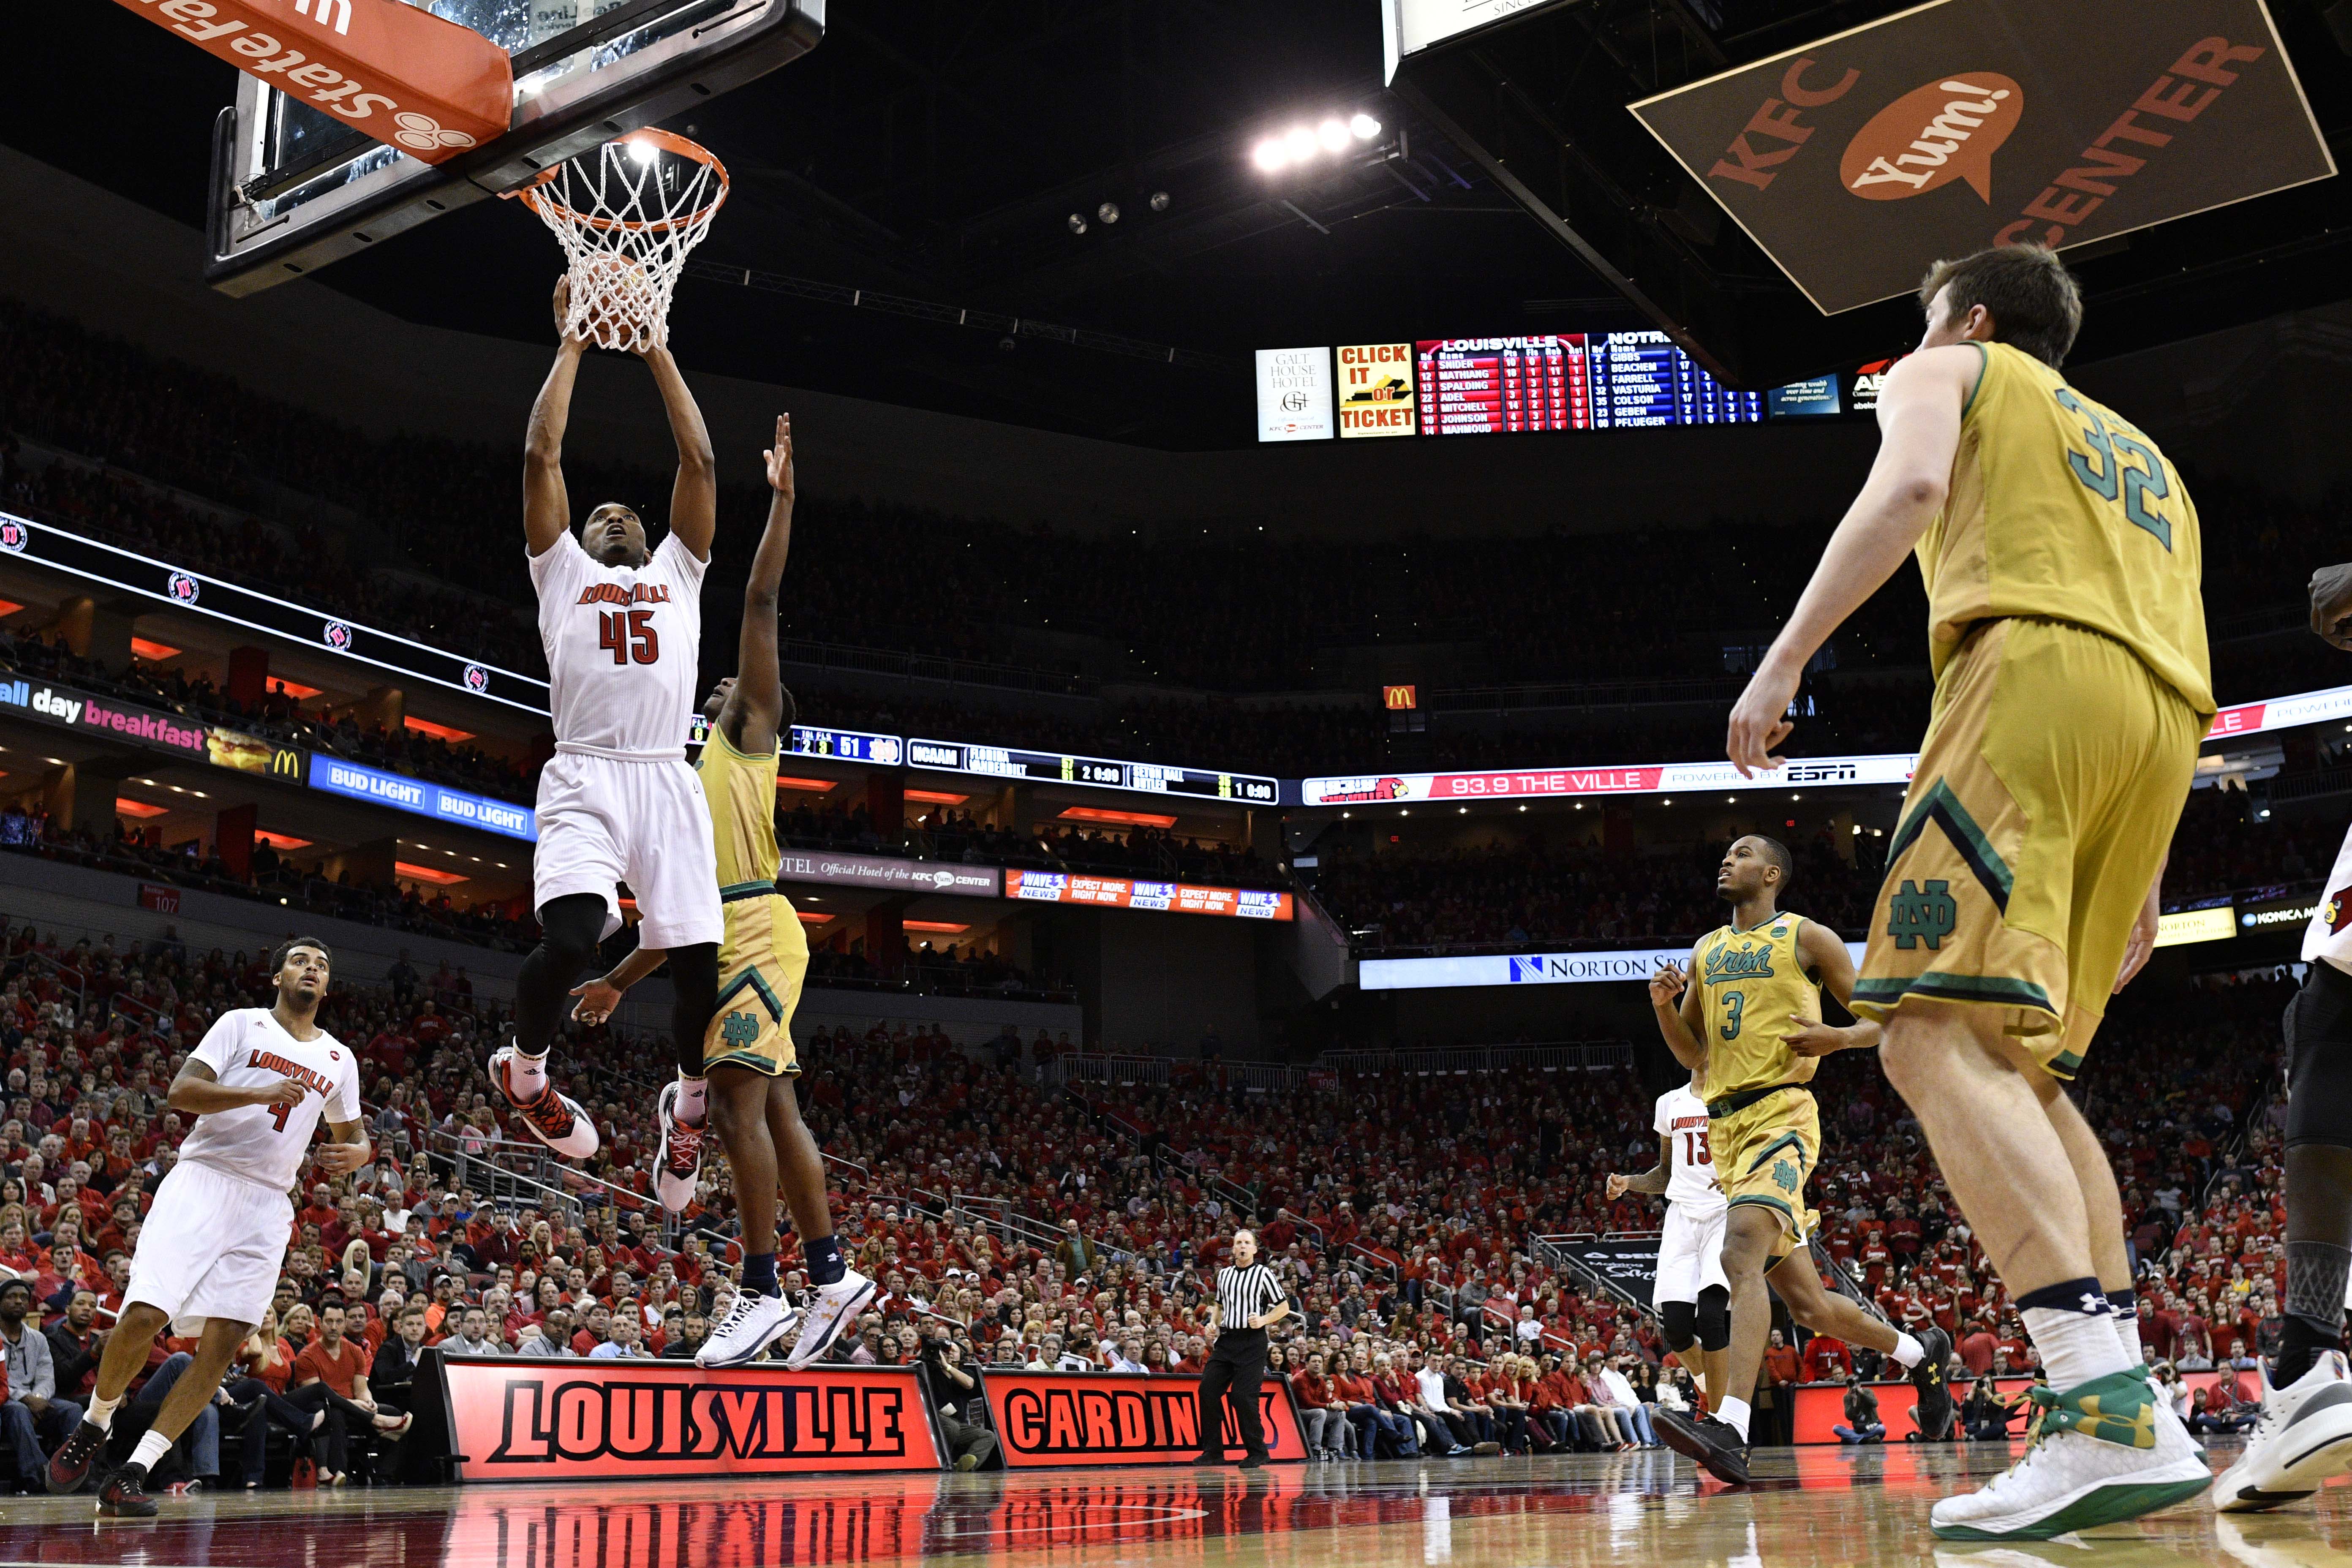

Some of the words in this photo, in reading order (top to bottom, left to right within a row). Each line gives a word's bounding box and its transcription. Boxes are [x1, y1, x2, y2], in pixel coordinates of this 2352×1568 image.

[1707, 58, 1860, 191] KFC
[1850, 81, 2010, 189] Yum!
[1992, 35, 2265, 250] CENTER
[1443, 335, 1558, 352] LOUISVILLE
[1608, 331, 1671, 344] NOTR
[1276, 353, 1309, 365] GALT
[1342, 346, 1407, 364] CLICK
[1595, 354, 1601, 362] 2
[1611, 353, 1640, 362] GIBBS
[1681, 351, 1686, 359] 2
[1271, 365, 1317, 376] HOUSE
[1439, 360, 1474, 369] SNIDER
[1505, 358, 1516, 366] 10
[1596, 365, 1602, 373] 3
[1611, 363, 1657, 372] BEACHEM
[1680, 361, 1689, 370] 17
[1272, 377, 1317, 388] HOTEL
[1350, 368, 1369, 384] IT
[1421, 373, 1431, 381] 12
[1439, 370, 1489, 380] MATHIANG
[1597, 376, 1603, 384] 5
[1612, 374, 1655, 384] FARRELL
[1682, 372, 1688, 381] 9
[1422, 384, 1432, 392] 13
[1440, 381, 1488, 391] SPALDING
[1509, 380, 1514, 388] 2
[1596, 387, 1606, 395] 32
[1612, 384, 1661, 395] VASTURIA
[1683, 383, 1689, 392] 4
[1372, 387, 1395, 401] or
[1422, 394, 1433, 403] 22
[1440, 393, 1465, 401] ADEL
[1510, 390, 1515, 399] 3
[1596, 397, 1607, 406] 35
[1613, 395, 1654, 405] COLSON
[1682, 393, 1693, 402] 17
[1423, 405, 1433, 413] 45
[1441, 402, 1488, 412] MITCHELL
[1508, 401, 1519, 409] 14
[1597, 408, 1608, 417] 23
[1614, 407, 1647, 416] GEBEN
[1685, 405, 1690, 414] 2
[1341, 408, 1413, 427] TICKET
[1424, 416, 1434, 424] 10
[1442, 414, 1487, 423] JOHNSON
[1511, 412, 1516, 420] 4
[1598, 419, 1609, 427] 00
[1615, 417, 1666, 427] PFLUEGER
[1686, 416, 1691, 425] 0
[1424, 427, 1434, 435] 14
[1442, 424, 1491, 434] MAHMOUD
[1511, 423, 1517, 431] 2
[2055, 388, 2172, 554] 32
[599, 610, 659, 665] 45
[2278, 699, 2352, 716] POWER
[0, 681, 29, 707] all
[33, 688, 82, 724] day
[85, 699, 203, 751] breakfast
[692, 718, 708, 728] FLS
[816, 731, 832, 740] FLS
[803, 740, 811, 753] 2
[840, 737, 859, 756] 51
[1083, 766, 1090, 779] 2
[1761, 771, 1781, 779] BY
[1788, 765, 1855, 781] ESPN
[331, 767, 368, 791] BUD
[370, 778, 422, 804] LIGHT
[1236, 783, 1242, 796] 1
[1452, 777, 1509, 794] 93.9
[1517, 776, 1565, 791] THE
[1572, 772, 1641, 789] VILLE
[441, 796, 475, 817] BUD
[477, 805, 524, 830] LIGHT
[821, 863, 855, 876] Official
[858, 864, 882, 878] Hotel
[885, 868, 896, 880] of
[896, 867, 909, 879] the
[911, 872, 932, 882] KFC
[936, 875, 953, 883] Yum!
[956, 878, 990, 887] CENTER
[1024, 873, 1052, 887] WAVE
[1050, 874, 1064, 889] 3
[1071, 879, 1101, 890] EXPECT
[1102, 882, 1127, 893] MORE.
[1134, 883, 1162, 897] WAVE
[1160, 884, 1173, 898] 3
[1023, 889, 1056, 898] NEWS
[1071, 889, 1096, 899] RIGHT
[1098, 891, 1117, 901] NOW.
[1180, 889, 1208, 899] EXPECT
[1210, 891, 1233, 901] MORE.
[1241, 892, 1267, 906] WAVE
[1264, 893, 1277, 907] 3
[156, 896, 177, 913] 107
[1134, 899, 1165, 907] NEWS
[1180, 898, 1204, 908] RIGHT
[1205, 901, 1224, 910] NOW.
[1241, 907, 1270, 916] NEWS
[2257, 909, 2303, 924] KONICA
[1551, 959, 1646, 977] NORTON
[1704, 942, 1774, 985] Irish
[1720, 991, 1744, 1040] 3
[246, 1049, 334, 1098] LOUISVILLE
[267, 1102, 297, 1133] 4
[1684, 1132, 1712, 1166] 13
[486, 1380, 905, 1463] LOUISVILLE
